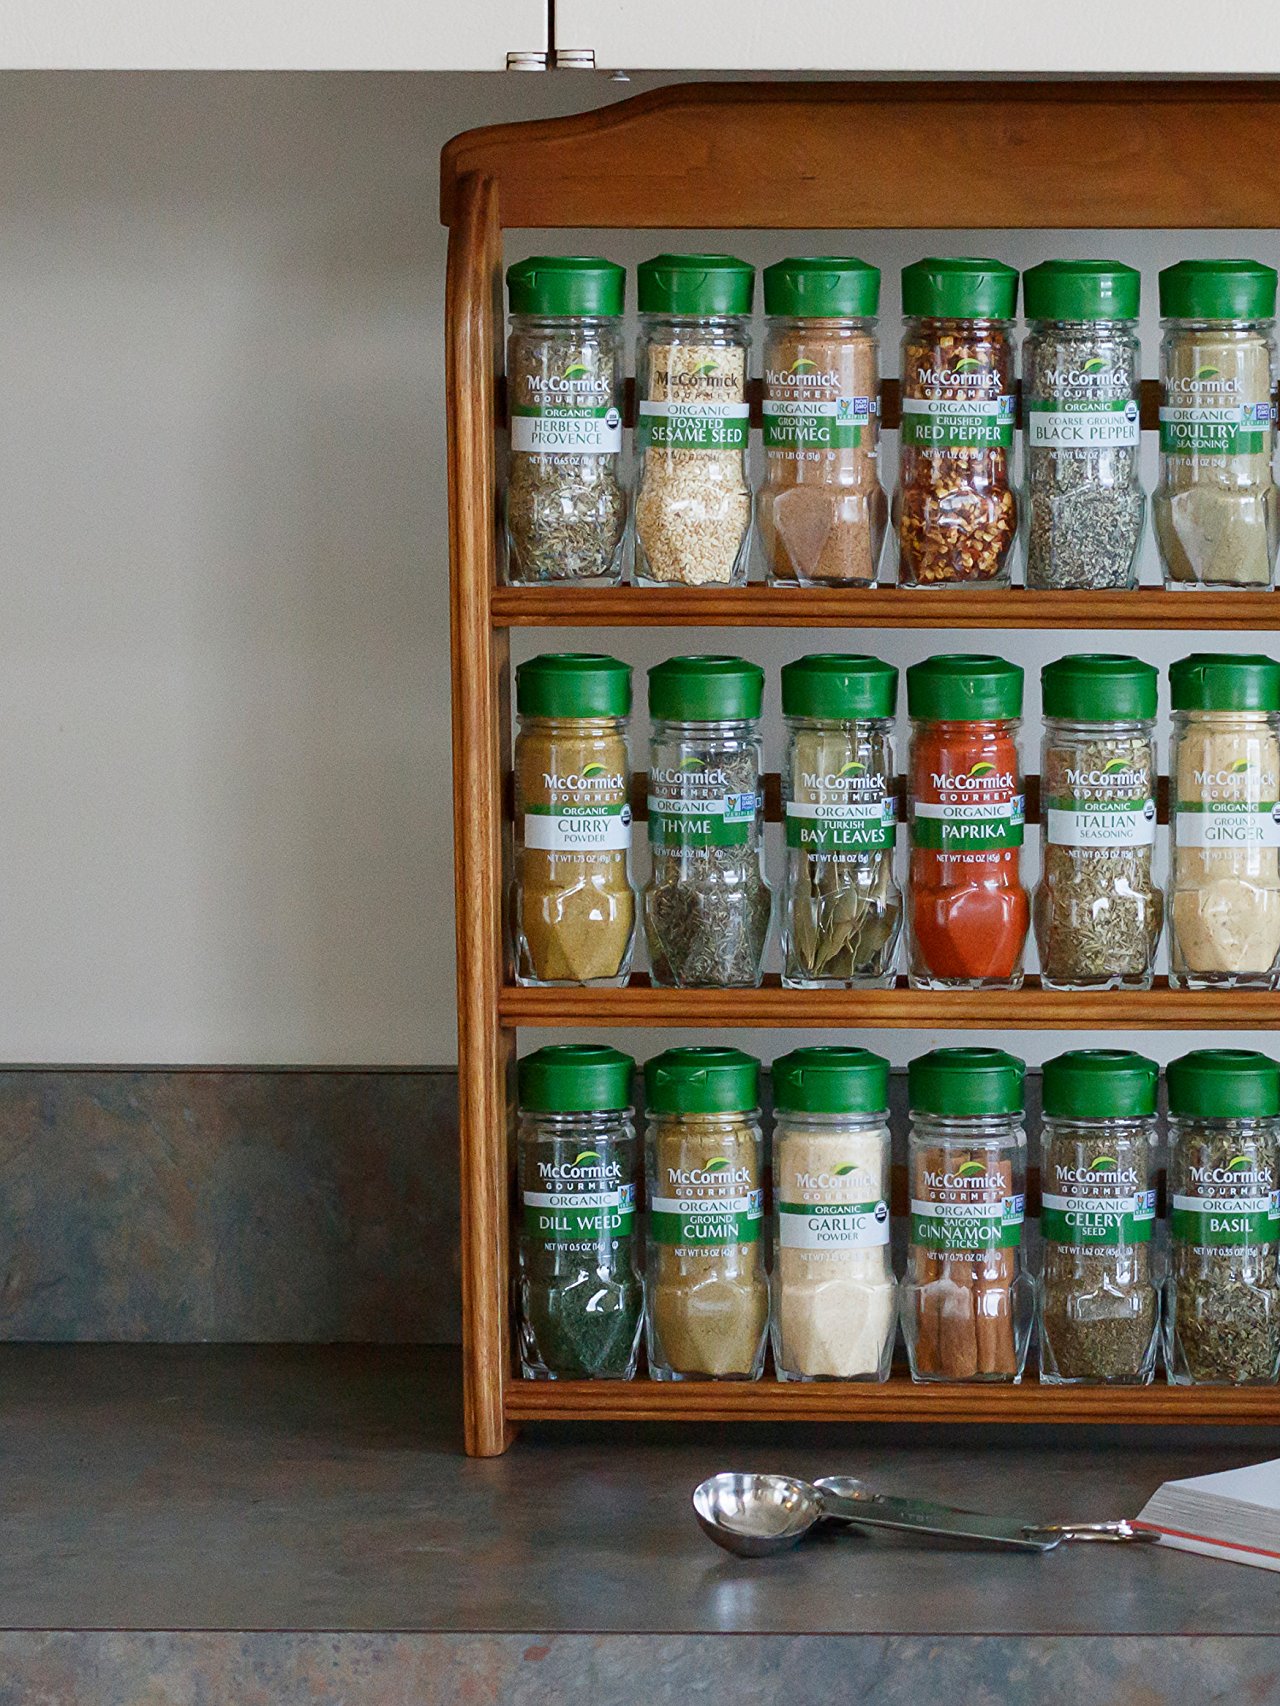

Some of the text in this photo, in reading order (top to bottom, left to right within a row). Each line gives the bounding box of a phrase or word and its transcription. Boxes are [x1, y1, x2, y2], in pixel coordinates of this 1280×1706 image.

[655, 371, 739, 387] McCormick
[766, 370, 841, 386] McCormick
[918, 368, 1002, 386] McCormick
[1044, 370, 1129, 386] McCormick
[527, 376, 610, 392] McCormick
[1165, 376, 1243, 393] McCormick
[925, 389, 992, 397] GOURMET
[1054, 390, 1122, 398] GOURMET
[668, 405, 729, 416] ORGANIC
[771, 403, 828, 413] ORGANIC
[929, 402, 991, 413] ORGANIC
[1065, 403, 1111, 411] ORGANIC
[545, 409, 591, 417] ORGANIC
[1173, 410, 1233, 420] ORGANIC
[534, 421, 598, 432] HERBES DE
[671, 419, 723, 429] TOASTED
[779, 417, 816, 426] GROUND
[937, 416, 982, 426] CRUSHED
[1049, 417, 1125, 425] COARSE GROUND
[652, 427, 742, 442] SESAME SEED
[770, 427, 830, 441] NUTMEG
[917, 426, 1000, 440] RED PEPPER
[1037, 425, 1135, 439] BLACK PEPPER
[1170, 424, 1237, 438] POULTRY
[532, 433, 601, 445] PROVENCE
[1177, 440, 1229, 449] SEASONING
[651, 766, 728, 785] McCormick
[802, 772, 886, 790] McCormick
[931, 772, 1014, 790] McCormick
[1065, 768, 1148, 786] McCormick
[543, 774, 625, 789] McCormick
[551, 792, 618, 801] GOURMET
[810, 792, 879, 801] GOURMET
[940, 792, 1007, 801] GOURMET
[1074, 789, 1141, 797] GOURMET
[563, 807, 608, 815] ORGANIC
[657, 800, 715, 812] ORGANIC
[815, 805, 877, 817] ORGANIC
[943, 805, 1004, 817] ORGANIC
[1085, 803, 1130, 811] ORGANIC
[558, 818, 611, 832] CURRY
[662, 819, 711, 833] THYME
[824, 820, 864, 829] TURKISH
[1076, 814, 1136, 828] ITALIAN
[801, 829, 885, 843] BAY LEAVES
[942, 824, 1006, 838] PAPRIKA
[1080, 829, 1133, 838] SEASONING
[1205, 826, 1264, 840] GINGER
[564, 834, 605, 842] POWDER
[808, 853, 856, 862] NET WT OZ
[937, 853, 986, 862] NET WT 1.62 OZ
[538, 1161, 621, 1179] McCormick
[668, 1167, 751, 1184] McCormick
[1056, 1165, 1139, 1183] McCormick
[1189, 1167, 1272, 1184] McCormick
[923, 1171, 1006, 1188] McCormick
[546, 1181, 616, 1190] GOURMET
[676, 1186, 746, 1196] GOURMET
[1062, 1186, 1130, 1195] GOURMET
[1198, 1186, 1266, 1195] GOURMET
[550, 1195, 611, 1206] ORGANIC
[930, 1191, 997, 1199] GOURMET
[679, 1200, 741, 1212] ORGANIC
[815, 1205, 860, 1213] ORGANIC
[935, 1205, 996, 1216] ORGANIC
[1066, 1200, 1128, 1211] ORGANIC
[1203, 1200, 1264, 1212] ORGANIC
[540, 1214, 621, 1230] DILL WEED
[690, 1215, 732, 1225] GROUND
[809, 1217, 865, 1231] GARLIC
[944, 1218, 981, 1227] SAIGON
[1065, 1213, 1124, 1227] CELERY
[1210, 1219, 1253, 1232] BASIL
[684, 1223, 739, 1238] CUMIN
[919, 1224, 1002, 1239] CINNAMON
[1082, 1227, 1106, 1236] SEED
[817, 1232, 858, 1241] POWDER
[945, 1239, 978, 1248] STICKS
[710, 1248, 720, 1256] OZ
[1095, 1248, 1104, 1256] OZ
